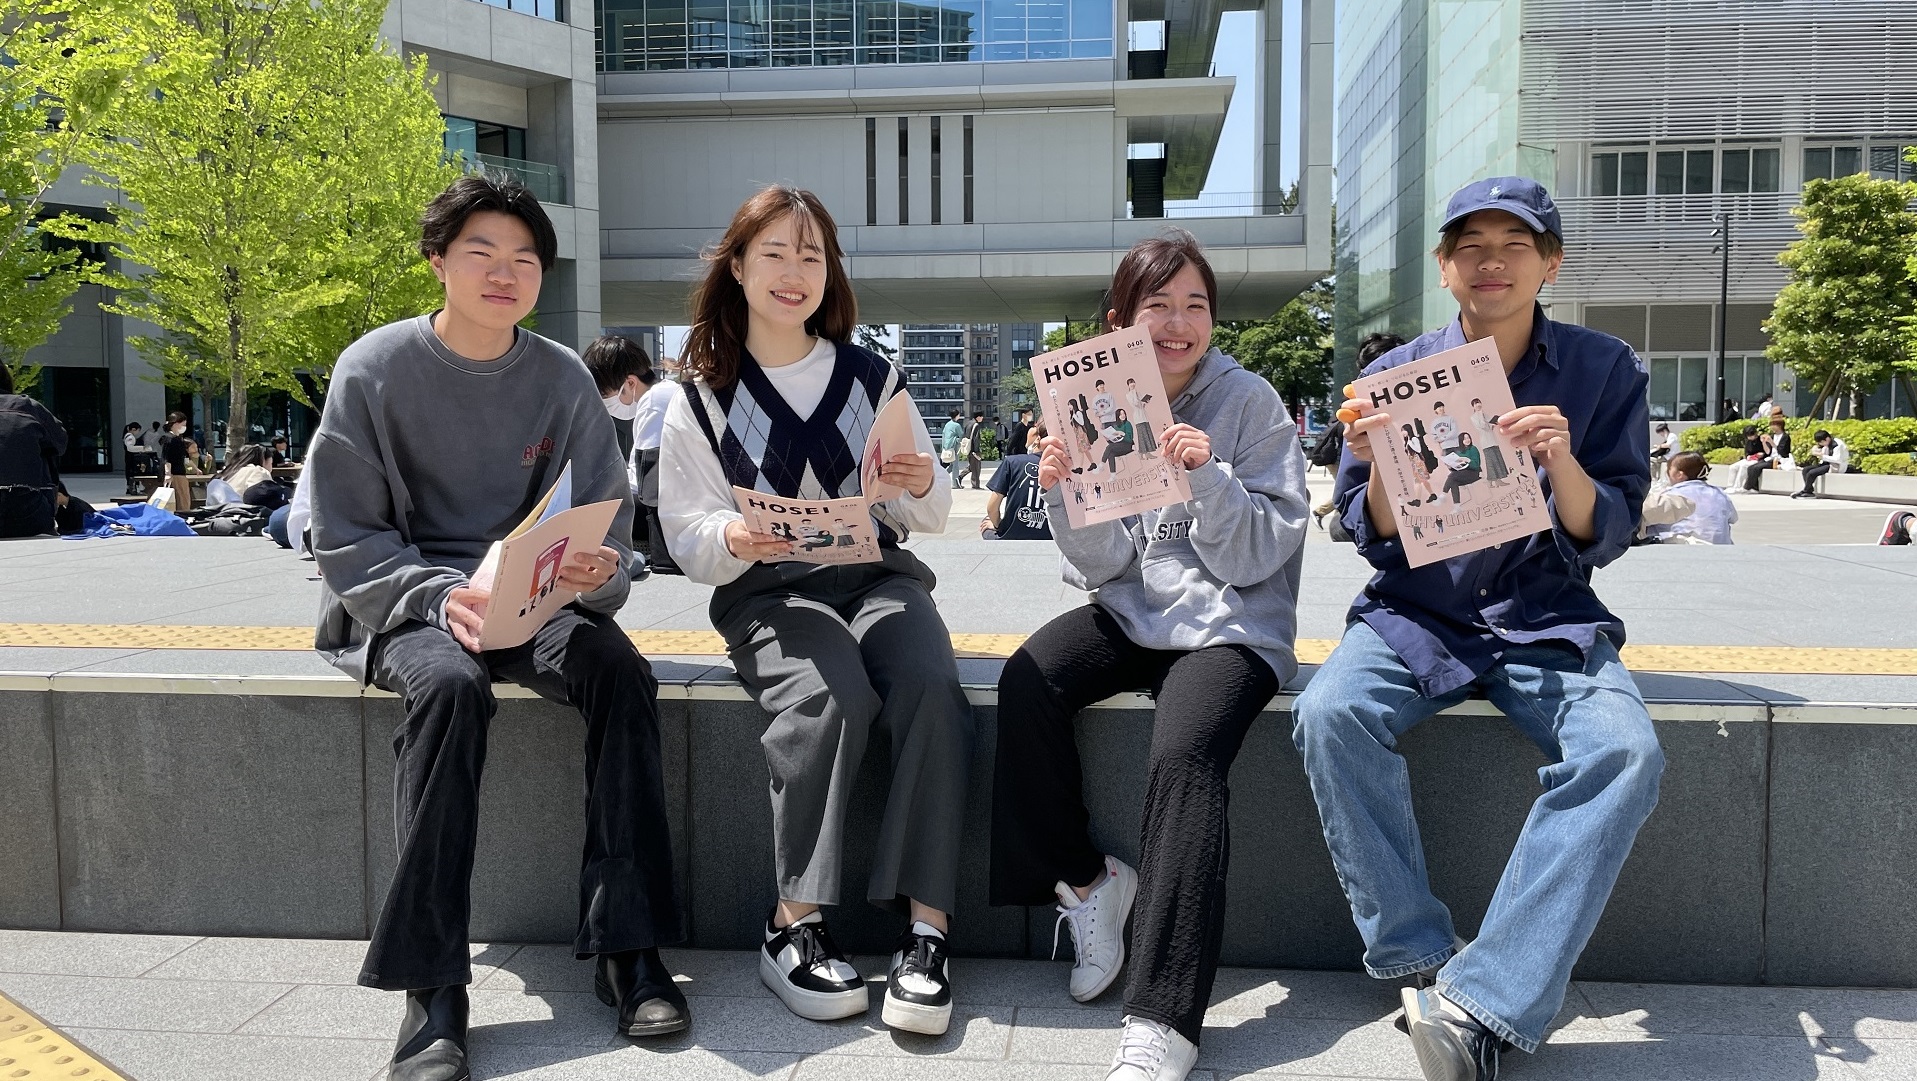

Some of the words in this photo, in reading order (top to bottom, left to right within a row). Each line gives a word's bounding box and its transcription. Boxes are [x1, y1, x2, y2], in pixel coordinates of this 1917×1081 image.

[1043, 347, 1120, 384] HOSEI
[1470, 358, 1480, 366] 04
[1480, 355, 1490, 363] 05
[1370, 365, 1462, 409] HOSEI
[1102, 459, 1179, 494] UNIVERSITY
[748, 497, 830, 515] HOSEI
